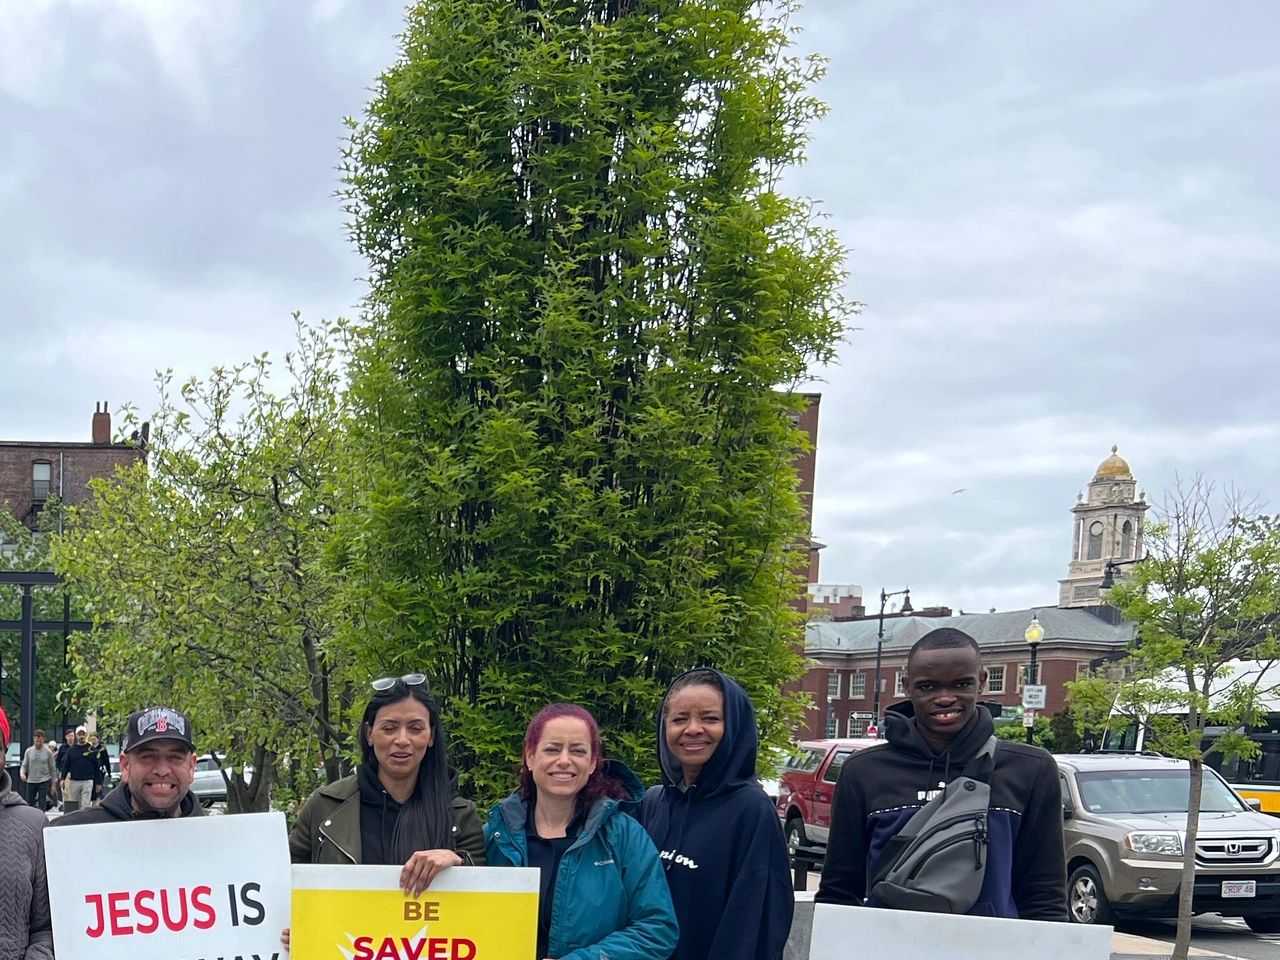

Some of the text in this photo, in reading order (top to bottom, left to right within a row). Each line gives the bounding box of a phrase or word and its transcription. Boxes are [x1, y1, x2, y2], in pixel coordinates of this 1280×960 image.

[84, 882, 266, 938] JESUS IS
[403, 901, 440, 921] BE
